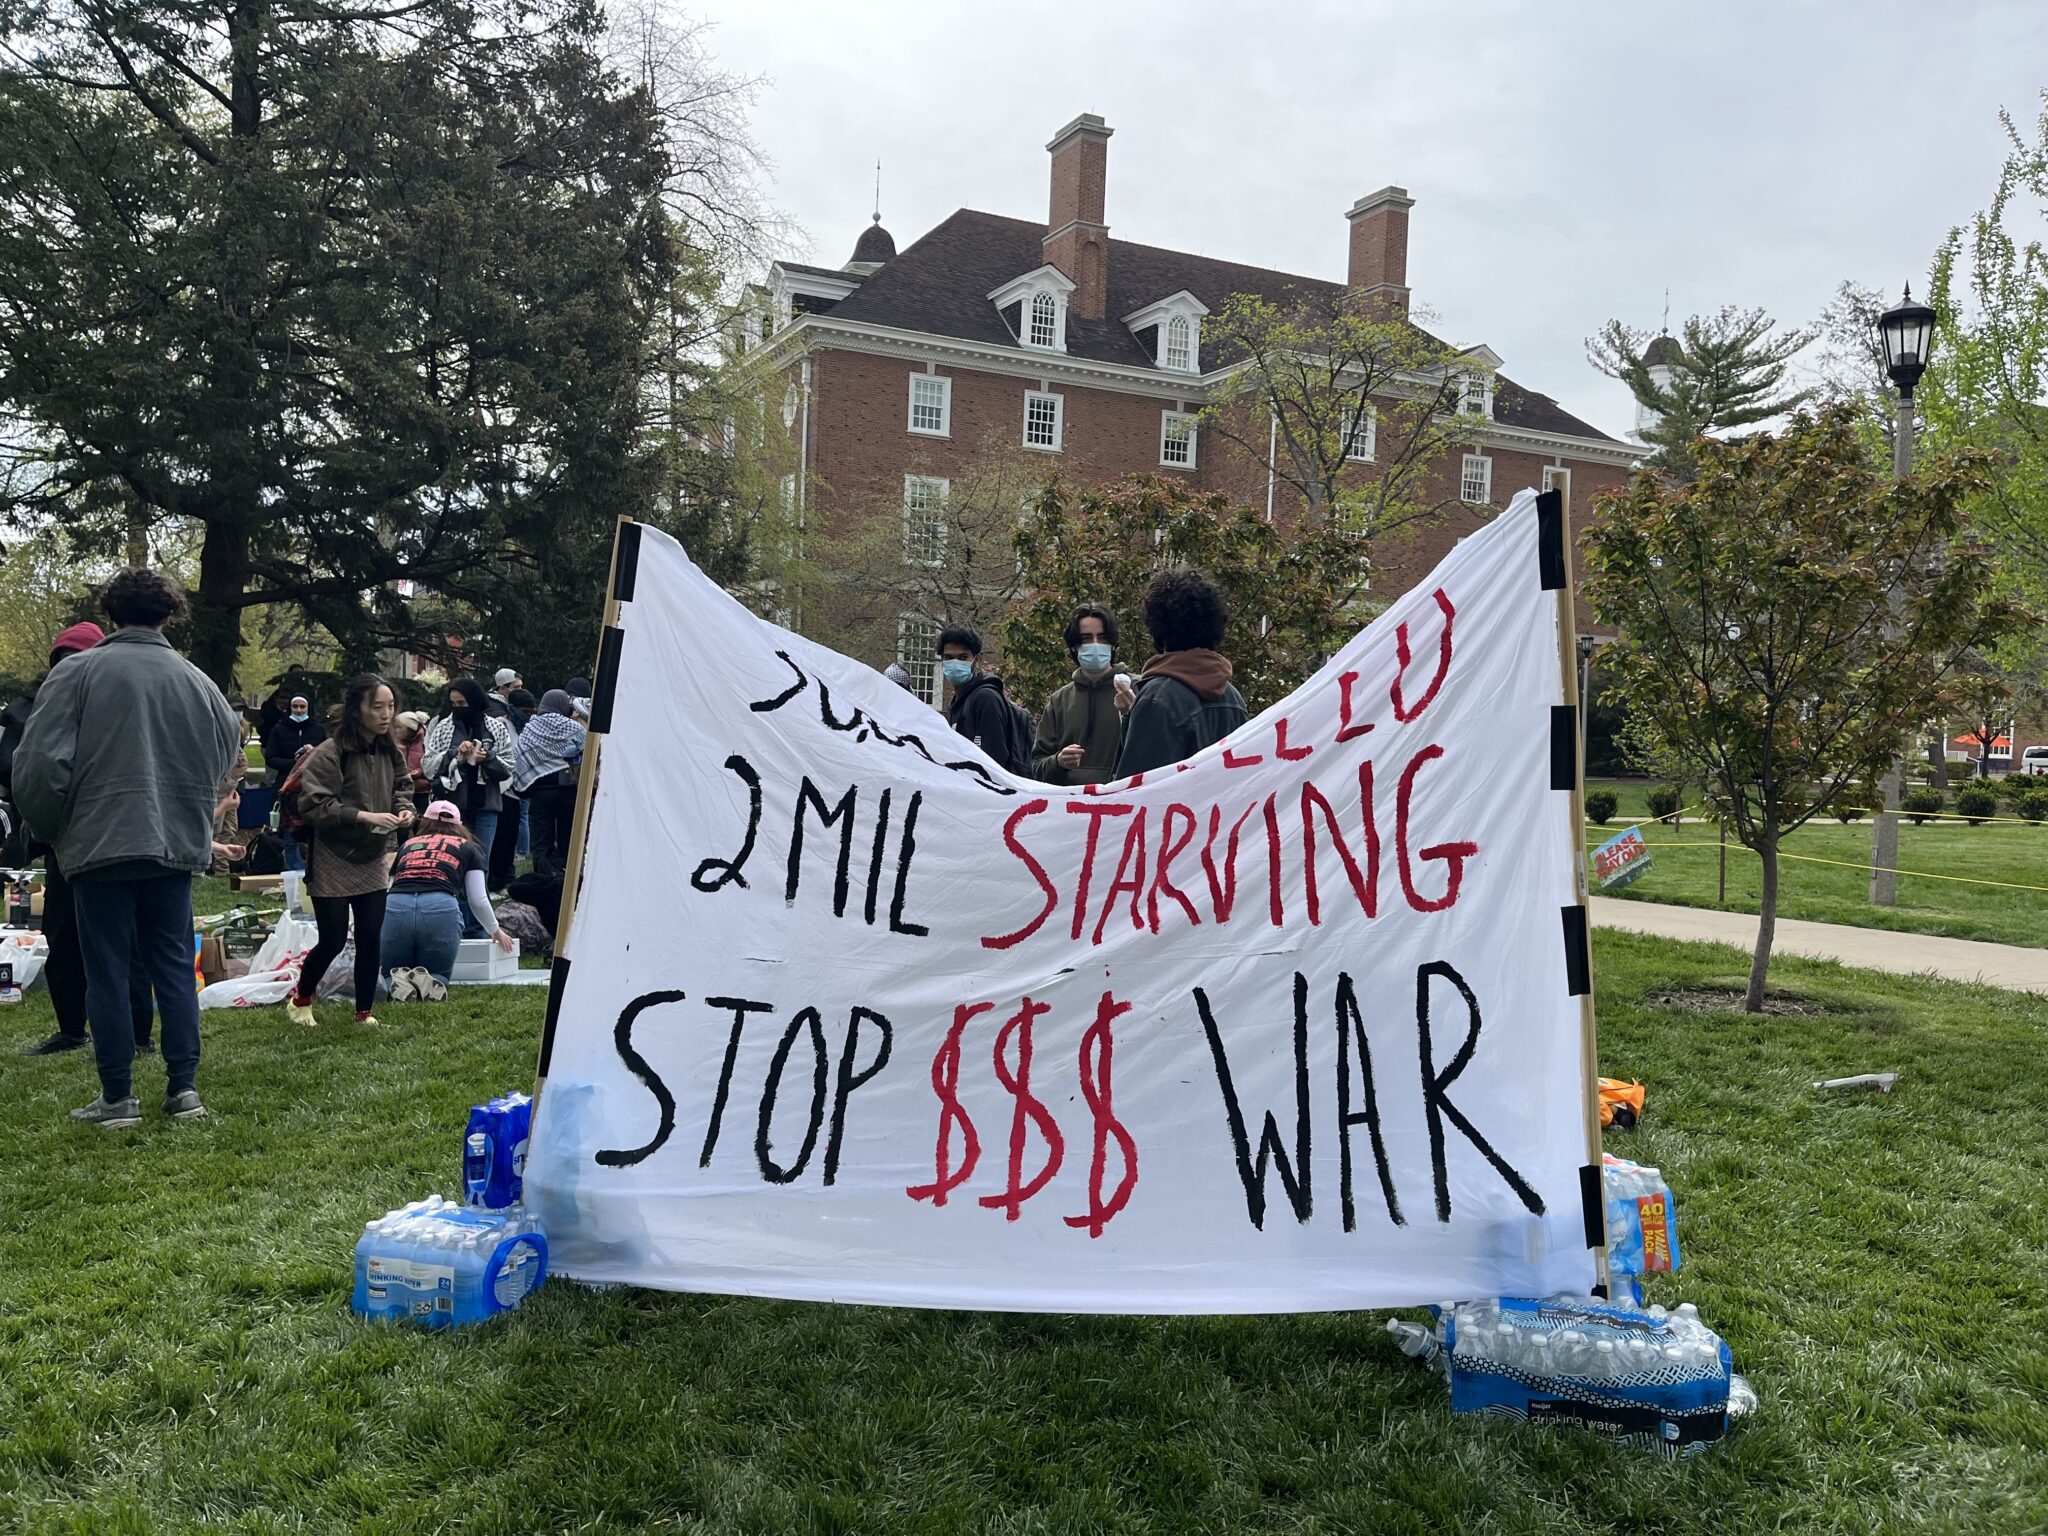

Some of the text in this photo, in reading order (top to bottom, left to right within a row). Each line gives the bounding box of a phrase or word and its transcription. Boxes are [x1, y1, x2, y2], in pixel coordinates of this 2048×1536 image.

[982, 743, 1479, 950] STARVING
[595, 960, 1546, 1238] STOP $$$ WAR
[1640, 1203, 1664, 1216] 40
[1644, 1230, 1655, 1255] PACK
[1586, 1418, 1623, 1432] water
